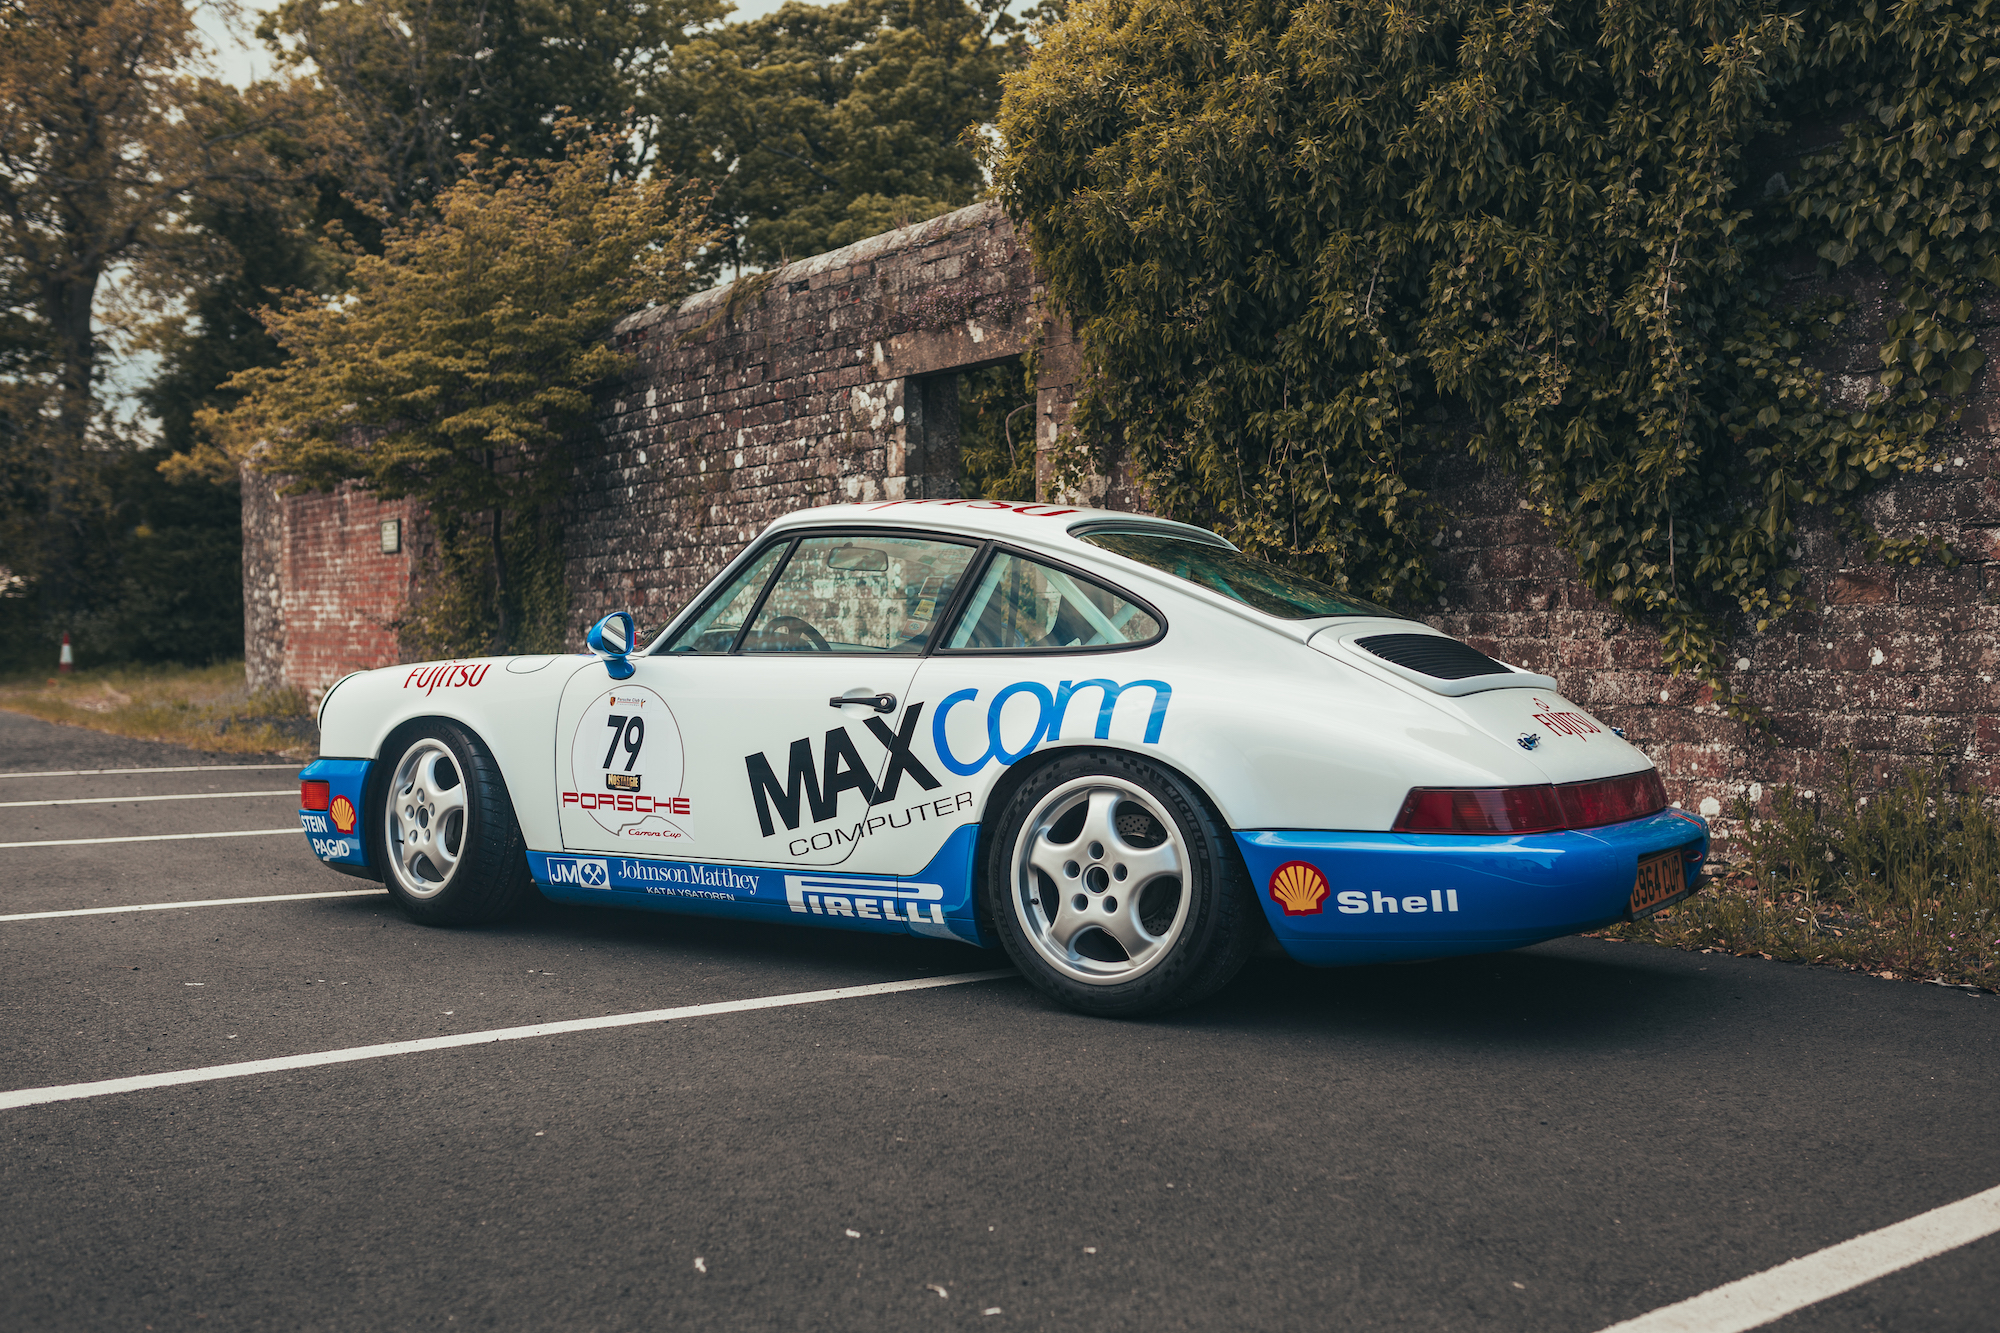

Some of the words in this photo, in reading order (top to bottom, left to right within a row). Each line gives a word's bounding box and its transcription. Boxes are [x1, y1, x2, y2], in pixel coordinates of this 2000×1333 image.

[403, 663, 492, 697] FUJITSU
[602, 714, 645, 772] 79
[1532, 712, 1602, 742] FUJITSU
[562, 791, 690, 815] PORSCHE
[628, 828, 661, 837] Carrera
[662, 830, 681, 839] Cup
[789, 791, 973, 857] COMPUTER
[1164, 785, 1209, 860] MICHELIN
[312, 838, 350, 857] PAGID
[552, 863, 579, 883] JM
[618, 859, 691, 883] Johnson
[689, 865, 760, 895] Matthey
[1662, 855, 1680, 894] CUP
[784, 875, 945, 924] PIRELLI
[1337, 889, 1459, 914] Shell
